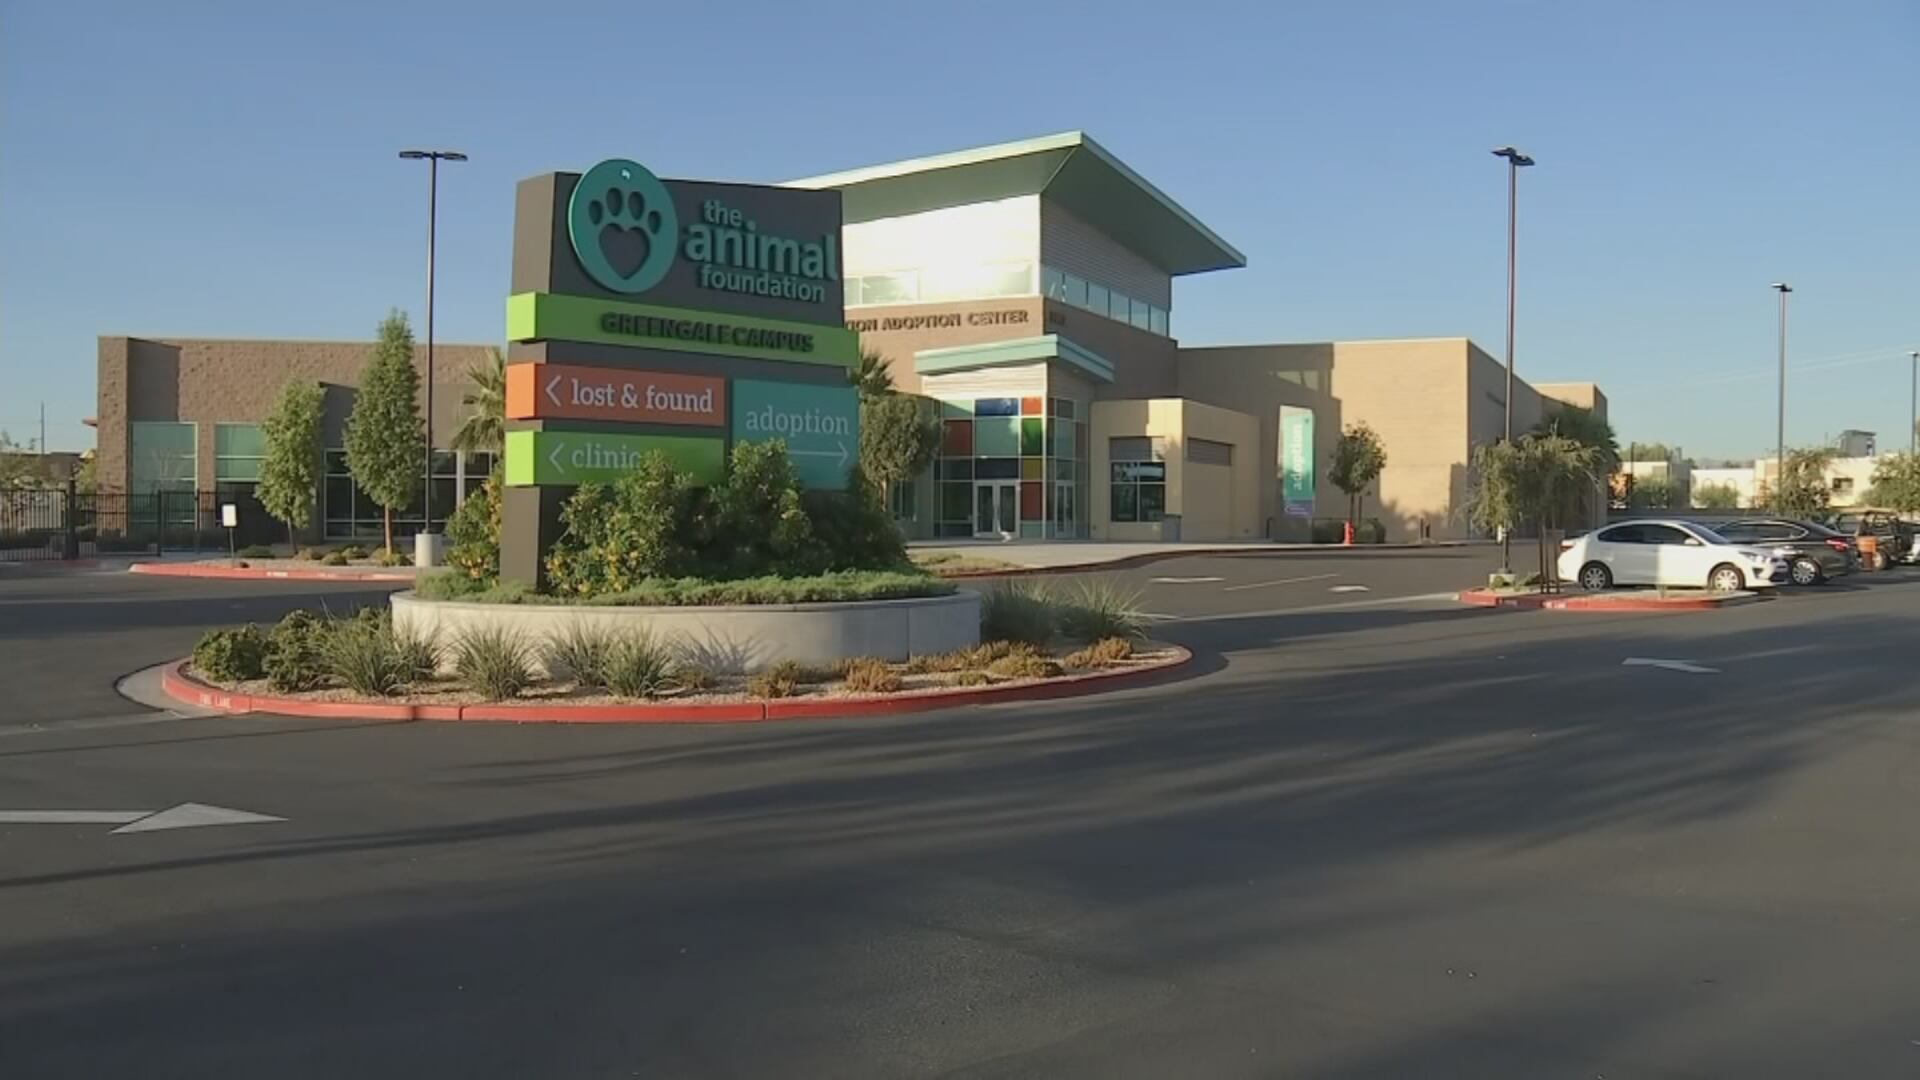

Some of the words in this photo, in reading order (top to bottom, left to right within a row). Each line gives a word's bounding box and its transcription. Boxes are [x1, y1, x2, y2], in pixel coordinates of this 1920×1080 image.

[704, 200, 742, 226] the
[684, 220, 838, 280] animal
[702, 264, 825, 302] foundation
[601, 312, 731, 345] GREENGALE
[731, 326, 815, 353] CAMPUS
[882, 313, 961, 331] ADOPTION
[967, 309, 1029, 326] CENTER
[571, 379, 615, 407] lost
[621, 383, 639, 408] &
[646, 385, 713, 413] found
[746, 404, 849, 437] adoption
